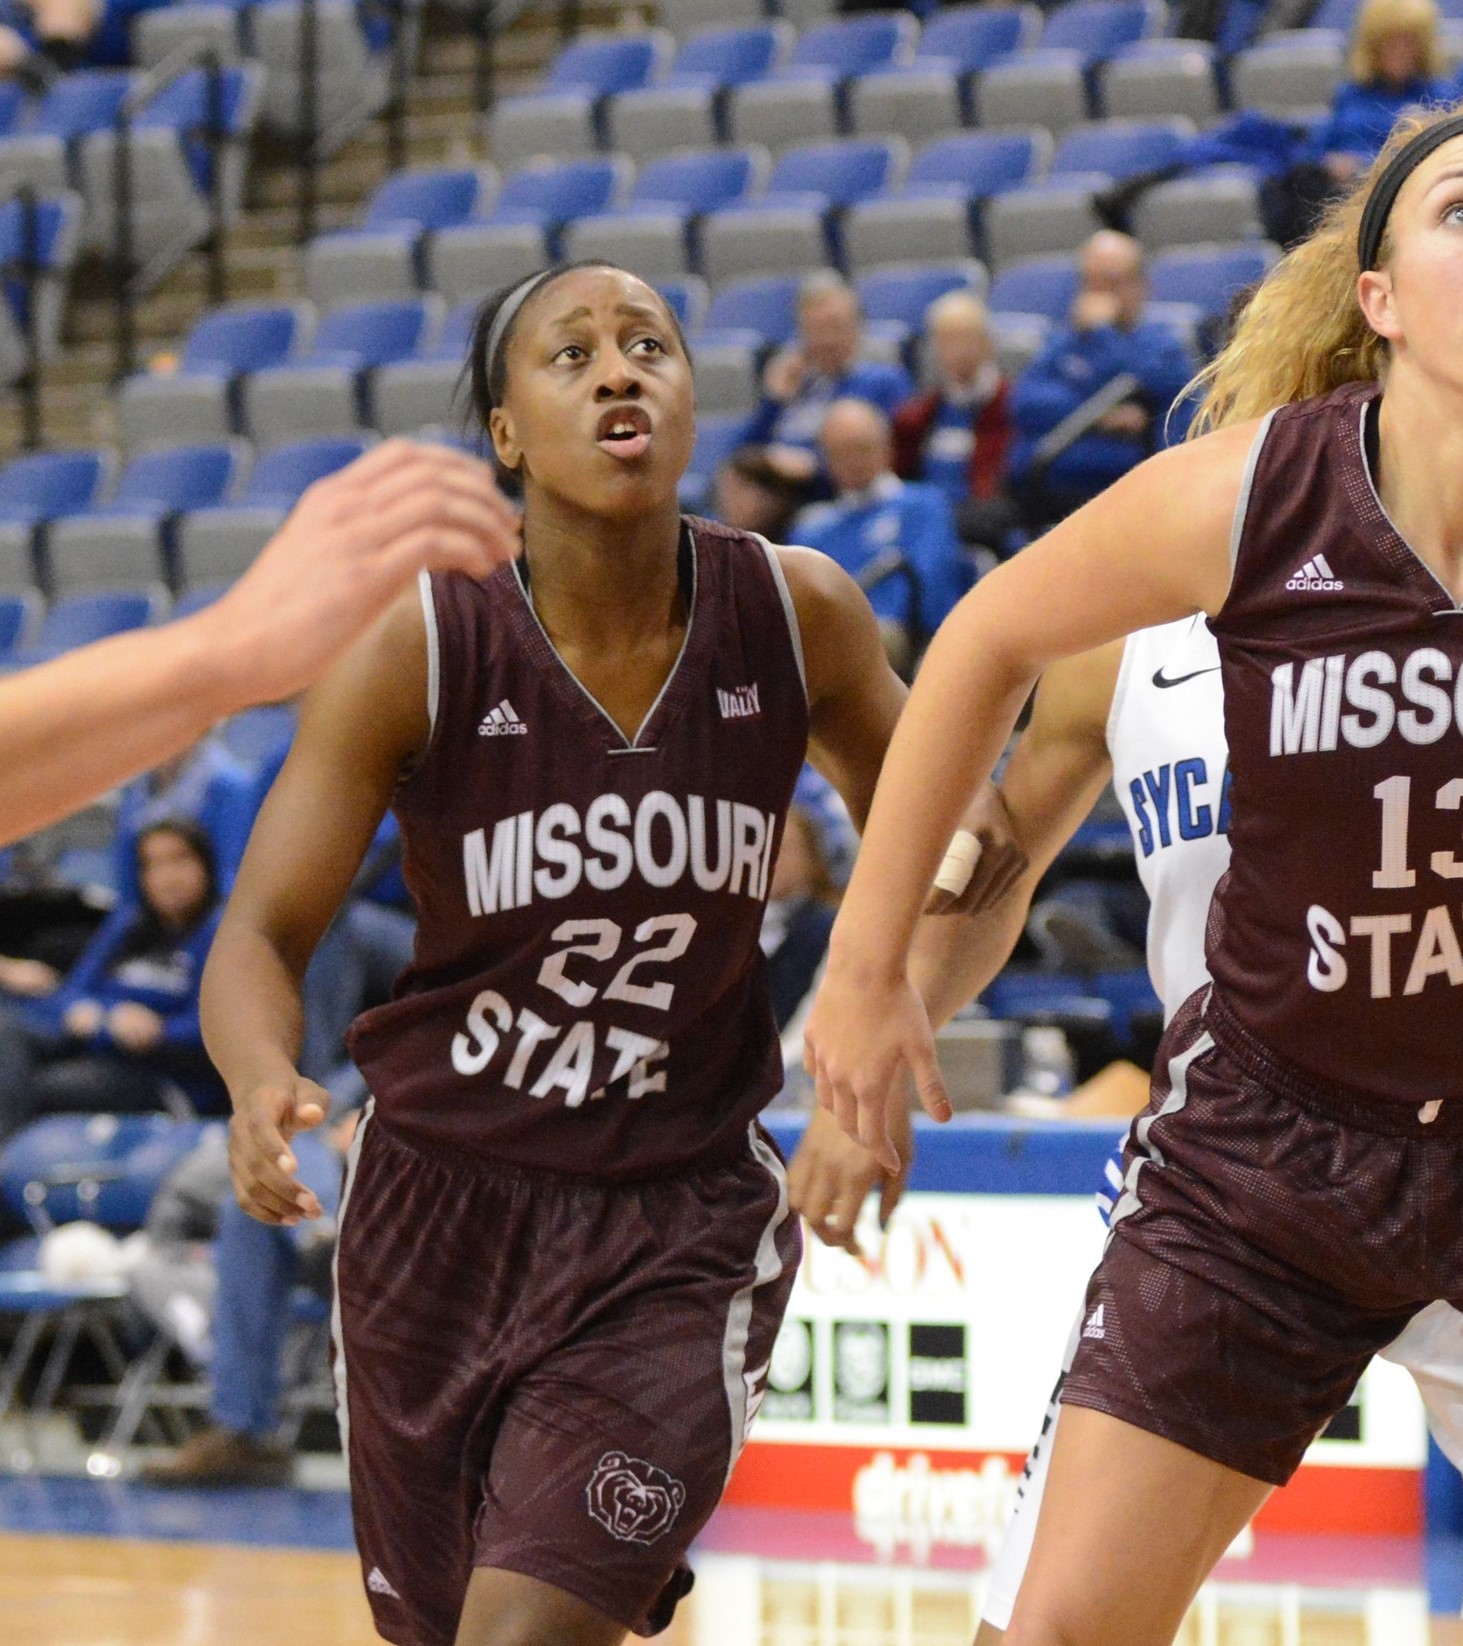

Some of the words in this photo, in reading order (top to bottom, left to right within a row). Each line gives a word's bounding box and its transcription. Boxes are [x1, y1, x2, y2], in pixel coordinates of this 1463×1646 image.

[1286, 577, 1344, 591] adidas
[478, 722, 528, 736] adidas
[463, 790, 776, 918] MISSOURI
[536, 912, 698, 1011] 22
[451, 990, 671, 1108] STATE
